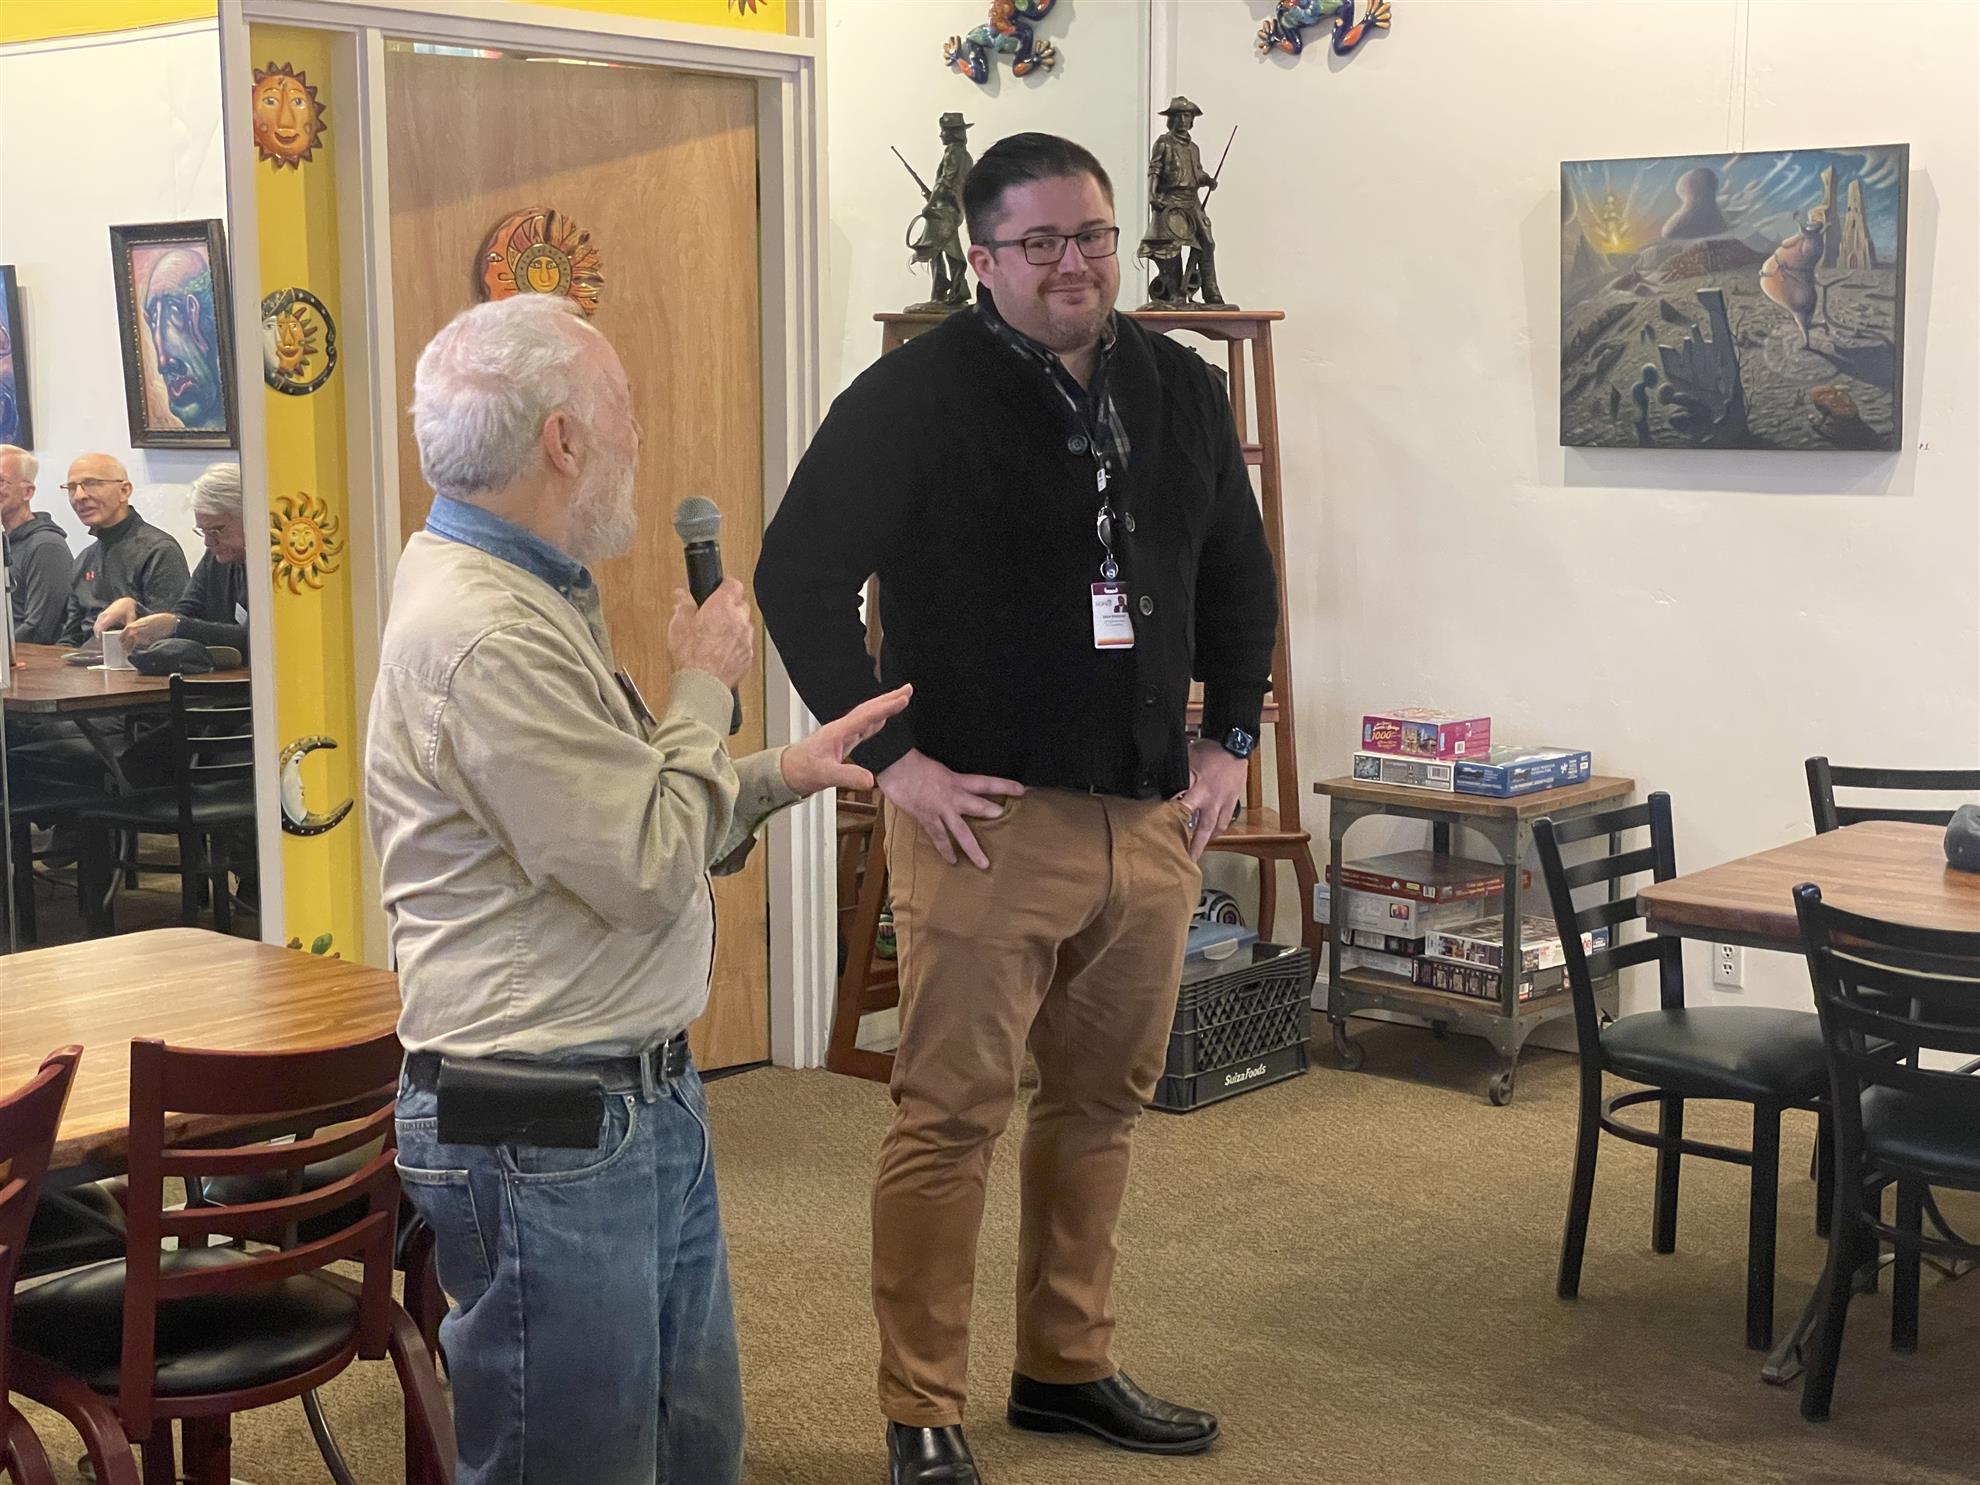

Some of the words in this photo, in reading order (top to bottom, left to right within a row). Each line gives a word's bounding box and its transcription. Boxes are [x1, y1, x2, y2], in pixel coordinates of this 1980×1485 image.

[1372, 730, 1392, 741] 1000
[1224, 1072, 1245, 1086] Suiza
[1244, 1063, 1267, 1080] Foods
